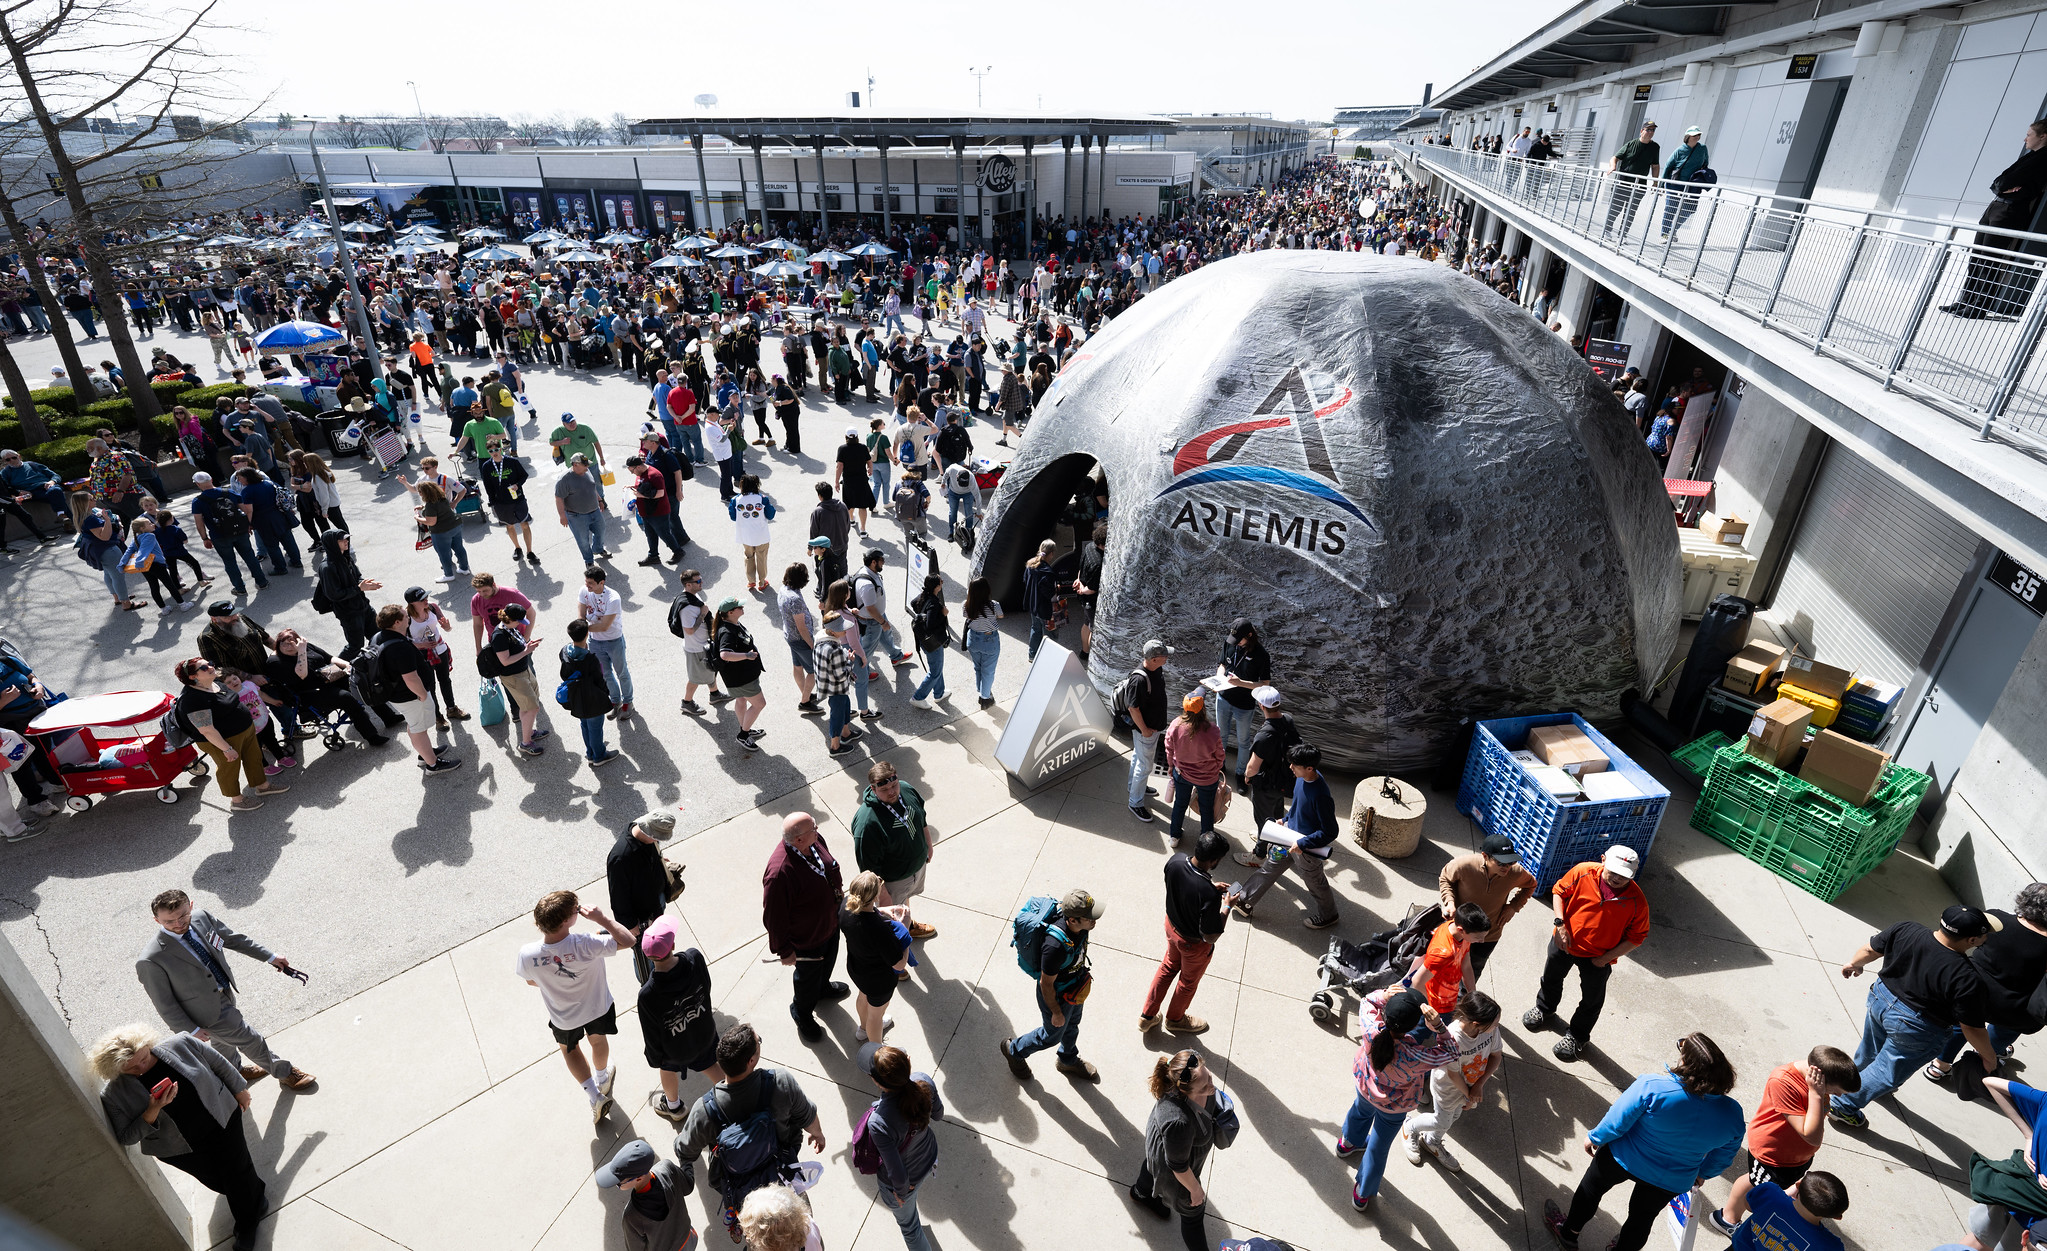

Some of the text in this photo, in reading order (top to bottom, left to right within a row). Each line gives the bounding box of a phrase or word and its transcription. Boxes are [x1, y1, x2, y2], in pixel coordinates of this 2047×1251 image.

[1776, 121, 1797, 144] 534
[975, 158, 1017, 186] Alley
[1605, 357, 1626, 365] ROCKET
[1170, 500, 1347, 555] ARTEMIS
[2011, 570, 2041, 602] 35
[1038, 737, 1096, 778] ARTEMIS
[671, 1004, 706, 1037] NASA
[1766, 1223, 1789, 1242] CITY
